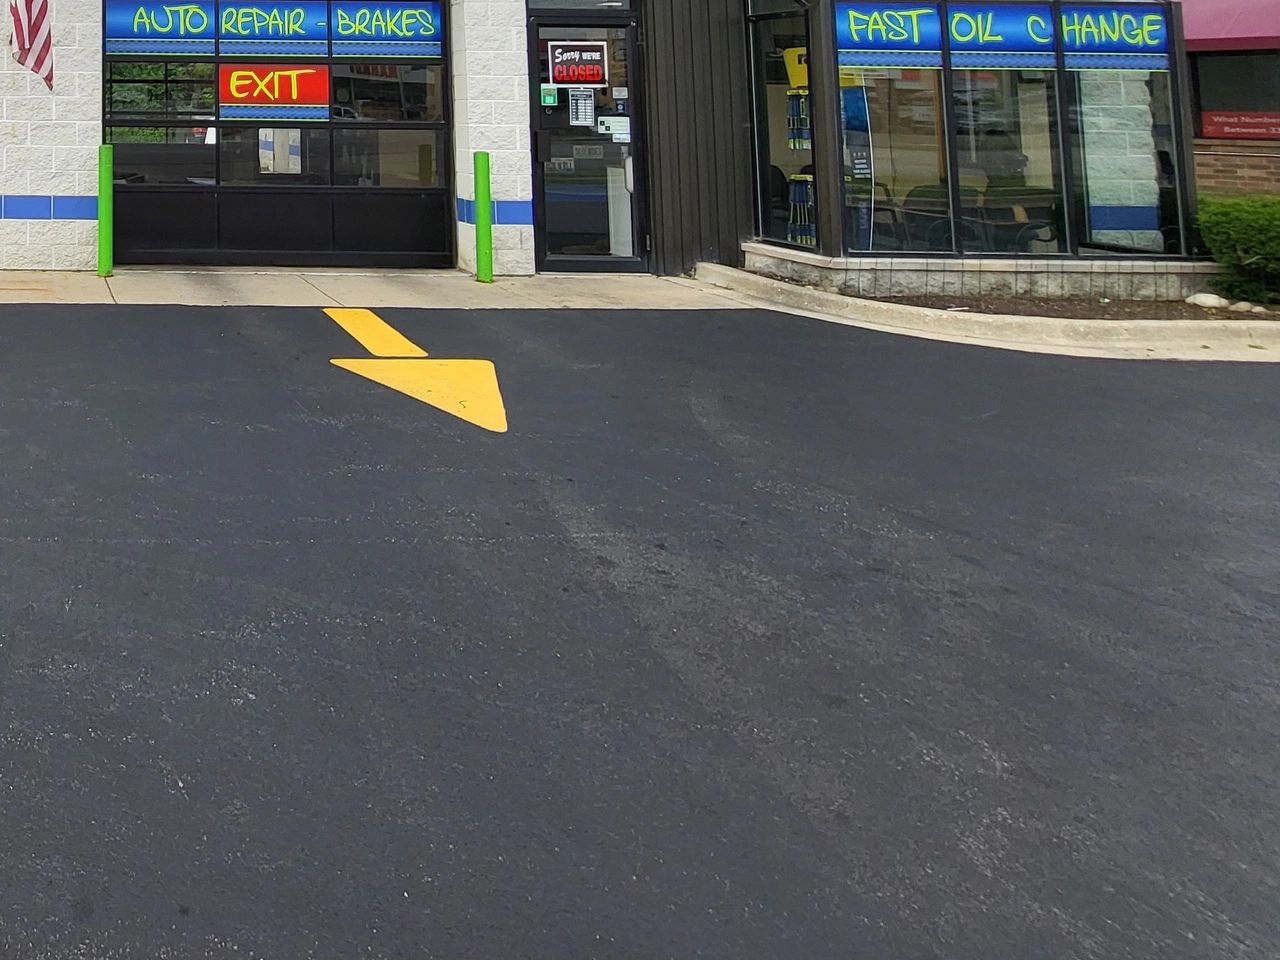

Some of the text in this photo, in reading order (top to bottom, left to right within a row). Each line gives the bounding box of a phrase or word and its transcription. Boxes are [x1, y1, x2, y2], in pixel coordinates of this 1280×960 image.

[133, 5, 209, 35] AUTO
[221, 7, 306, 36] REPAIR
[337, 8, 435, 37] BRAKES
[847, 8, 935, 43] FAST
[950, 11, 1004, 43] OIL
[554, 48, 580, 63] Sorry
[229, 69, 317, 101] EXIT
[553, 64, 603, 81] CLOSED
